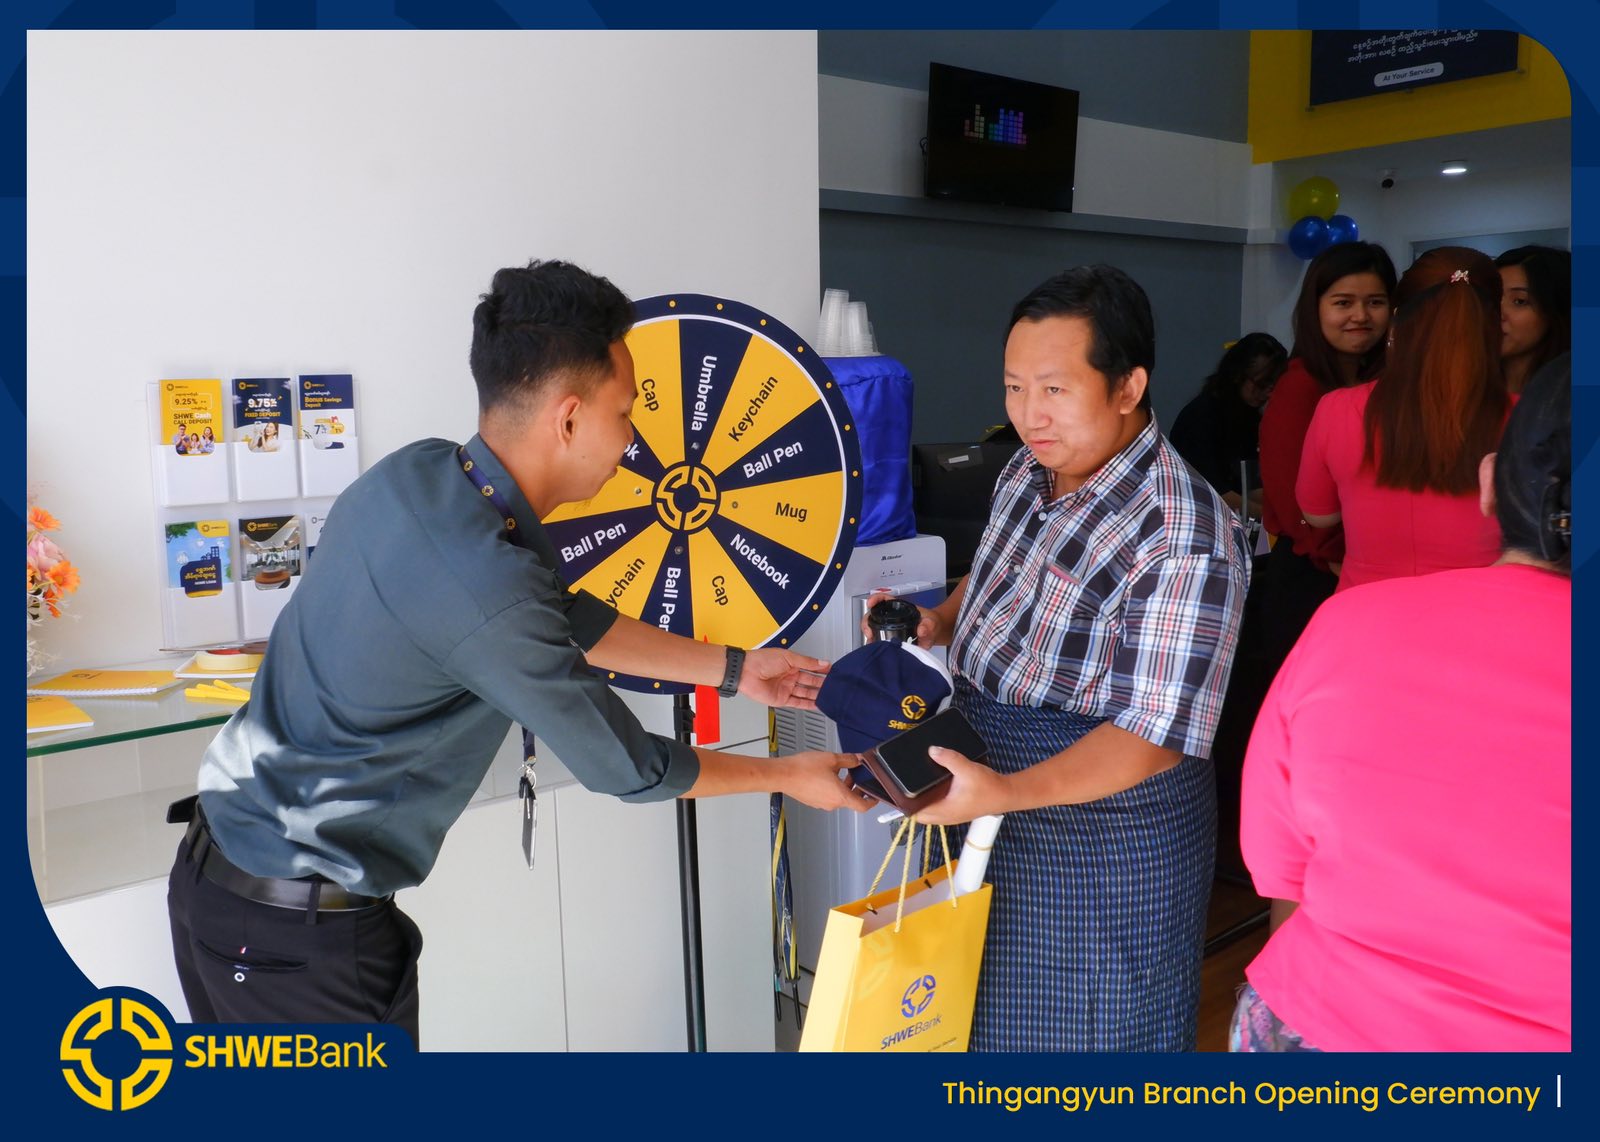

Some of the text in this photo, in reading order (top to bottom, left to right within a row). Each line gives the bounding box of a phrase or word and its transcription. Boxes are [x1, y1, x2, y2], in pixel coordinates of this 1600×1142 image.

[1383, 67, 1435, 82] At Your Service
[174, 398, 198, 406] 9.25%
[641, 378, 660, 412] Cap
[691, 355, 718, 431] Umbrella
[728, 376, 779, 442] Keychain
[743, 441, 803, 479] Ball Pen
[775, 502, 808, 522] Mug
[560, 522, 627, 563] Ball Pen
[730, 533, 791, 590] Notebook
[605, 557, 646, 608] ychain
[663, 566, 682, 599] Ball
[711, 575, 729, 606] Cap
[881, 1013, 943, 1050] SHWEBank
